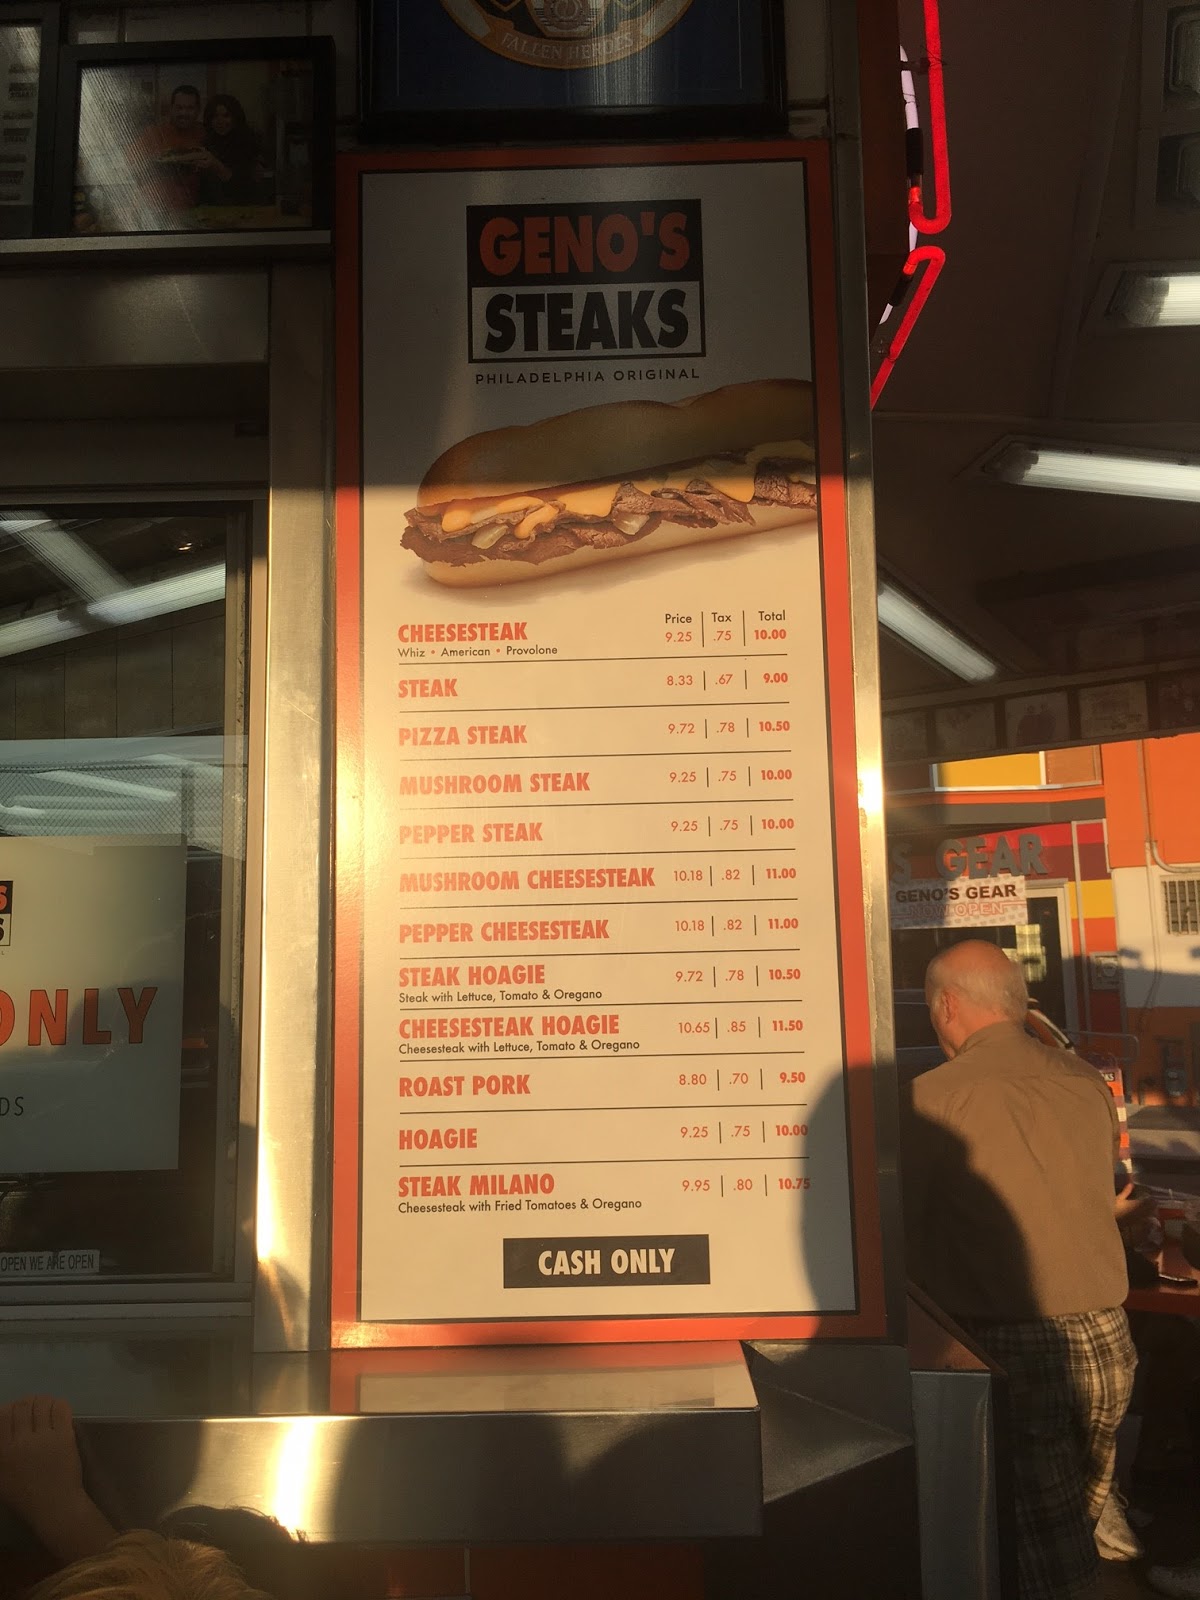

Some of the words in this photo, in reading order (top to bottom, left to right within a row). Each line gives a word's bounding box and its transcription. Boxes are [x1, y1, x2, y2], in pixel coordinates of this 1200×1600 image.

[502, 32, 562, 60] FALLEN
[479, 212, 690, 276] GENO'S
[485, 288, 689, 352] STEAKS
[475, 370, 605, 385] PHILADELPHIA
[613, 368, 700, 381] ORIGINAL
[664, 613, 693, 624] Price
[712, 612, 732, 624] Tax
[758, 610, 786, 622] Total
[398, 622, 528, 643] CHEESESTEAK
[665, 631, 693, 643] 9.25
[712, 630, 732, 642] .75
[754, 629, 787, 641] 10.00
[398, 647, 426, 658] Whiz
[441, 646, 491, 657] American
[506, 645, 558, 656] Provolone
[398, 679, 458, 698] STEAK
[667, 674, 693, 686] 8.33
[715, 673, 733, 685] .67
[763, 672, 788, 684] 9.00
[398, 727, 460, 746] PIZZA
[467, 725, 527, 745] STEAK
[668, 723, 695, 735] 9.72
[716, 722, 735, 733] .78
[758, 720, 791, 732] 10.50
[399, 774, 522, 795] MUSHROOM
[530, 772, 590, 792] STEAK
[669, 771, 696, 783] 9.25
[718, 770, 737, 782] .75
[761, 769, 792, 781] 10.00
[399, 825, 475, 845] PEPPER
[483, 822, 543, 842] STEAK
[670, 820, 699, 833] 9.25
[719, 819, 739, 831] .75
[762, 818, 795, 830] 10.00
[936, 833, 1048, 881] GEAR
[400, 870, 520, 892] MUSHROOM
[527, 868, 655, 890] CHEESESTEAK
[673, 869, 703, 882] 10.18
[721, 868, 741, 880] .82
[766, 867, 797, 880] 11.00
[895, 888, 960, 903] GENO'S
[966, 885, 1017, 899] GEAR
[954, 902, 1004, 916] OPEN
[399, 923, 473, 943] PEPPER
[481, 920, 610, 941] CHEESESTEAK
[675, 919, 705, 932] 10.18
[723, 918, 743, 931] .82
[768, 917, 799, 929] 11.00
[399, 966, 460, 987] STEAK
[468, 965, 545, 985] HOAGIE
[675, 970, 703, 983] 9.72
[725, 969, 745, 981] .78
[769, 968, 801, 980] 10.50
[399, 992, 428, 1003] Steak
[431, 992, 453, 1002] with
[457, 991, 496, 1003] Lettuce,
[500, 991, 538, 1001] Tomato
[543, 990, 551, 1000] &
[554, 989, 603, 1002] Oregano
[399, 1017, 534, 1039] CHEESESTEAK
[542, 1015, 620, 1035] HOAGIE
[678, 1020, 710, 1033] 10.65
[726, 1020, 746, 1033] .85
[772, 1019, 803, 1032] 11.50
[399, 1043, 464, 1055] Cheesesteak
[468, 1042, 490, 1053] with
[493, 1041, 534, 1053] Lettuce,
[537, 1041, 575, 1051] Tomato
[580, 1040, 588, 1050] &
[591, 1039, 640, 1052] Oregano
[399, 1076, 465, 1096] ROAST
[472, 1075, 531, 1095] PORK
[679, 1073, 707, 1086] 8.80
[728, 1072, 748, 1084] .70
[779, 1071, 806, 1084] 9.50
[399, 1128, 477, 1149] HOAGIE
[680, 1125, 709, 1139] 9.25
[731, 1125, 751, 1138] .75
[775, 1123, 809, 1137] 10.00
[398, 1176, 461, 1197] STEAK
[470, 1173, 555, 1195] MILANO
[682, 1179, 710, 1192] 9.95
[733, 1178, 753, 1191] .80
[778, 1177, 810, 1191] 10.75
[398, 1202, 466, 1213] Cheesesteak
[469, 1200, 491, 1212] with
[495, 1200, 523, 1211] Fried
[526, 1199, 576, 1211] Tomatoes
[580, 1199, 589, 1209] &
[592, 1198, 642, 1211] Oregano
[1, 1257, 26, 1271] OPEN
[30, 1256, 44, 1270] WE
[47, 1255, 65, 1270] ARE
[68, 1254, 94, 1269] OPEN
[538, 1250, 601, 1275] CASH
[611, 1248, 675, 1274] ONLY
